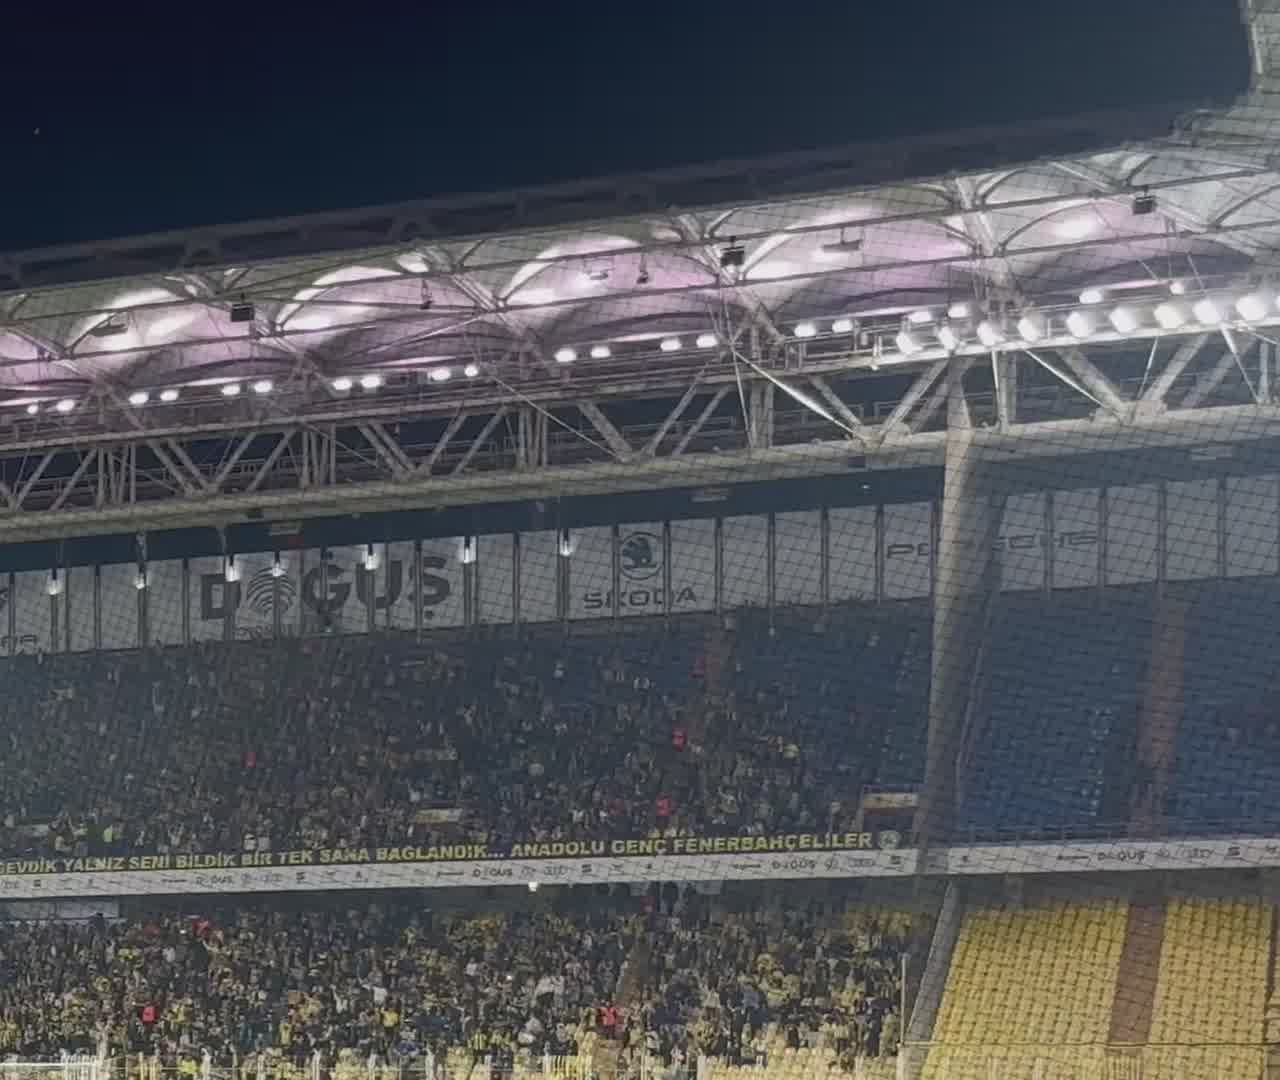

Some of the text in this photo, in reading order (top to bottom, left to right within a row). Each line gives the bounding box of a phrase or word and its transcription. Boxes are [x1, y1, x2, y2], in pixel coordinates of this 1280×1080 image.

[511, 841, 605, 857] ANADOLU
[611, 838, 666, 855] GENÇ
[63, 856, 124, 872] YALNIZ
[278, 850, 312, 864] TEK
